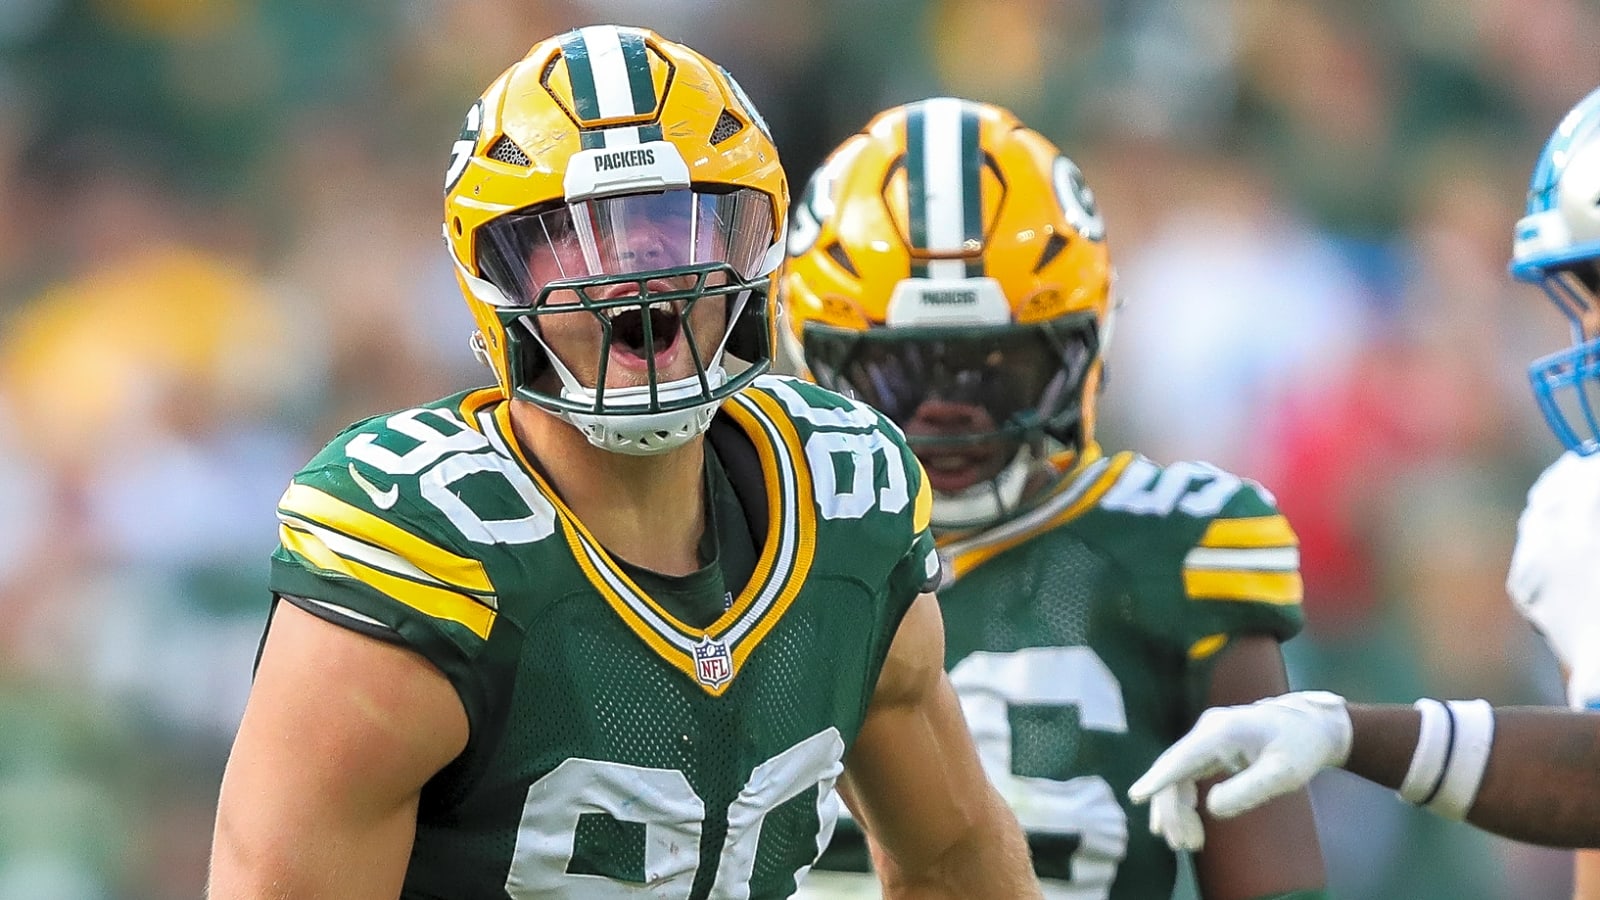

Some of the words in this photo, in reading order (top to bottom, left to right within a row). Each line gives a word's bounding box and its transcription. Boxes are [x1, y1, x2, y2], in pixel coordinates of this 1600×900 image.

[594, 149, 655, 172] PACKERS
[346, 408, 556, 544] 90
[701, 658, 728, 680] NFL
